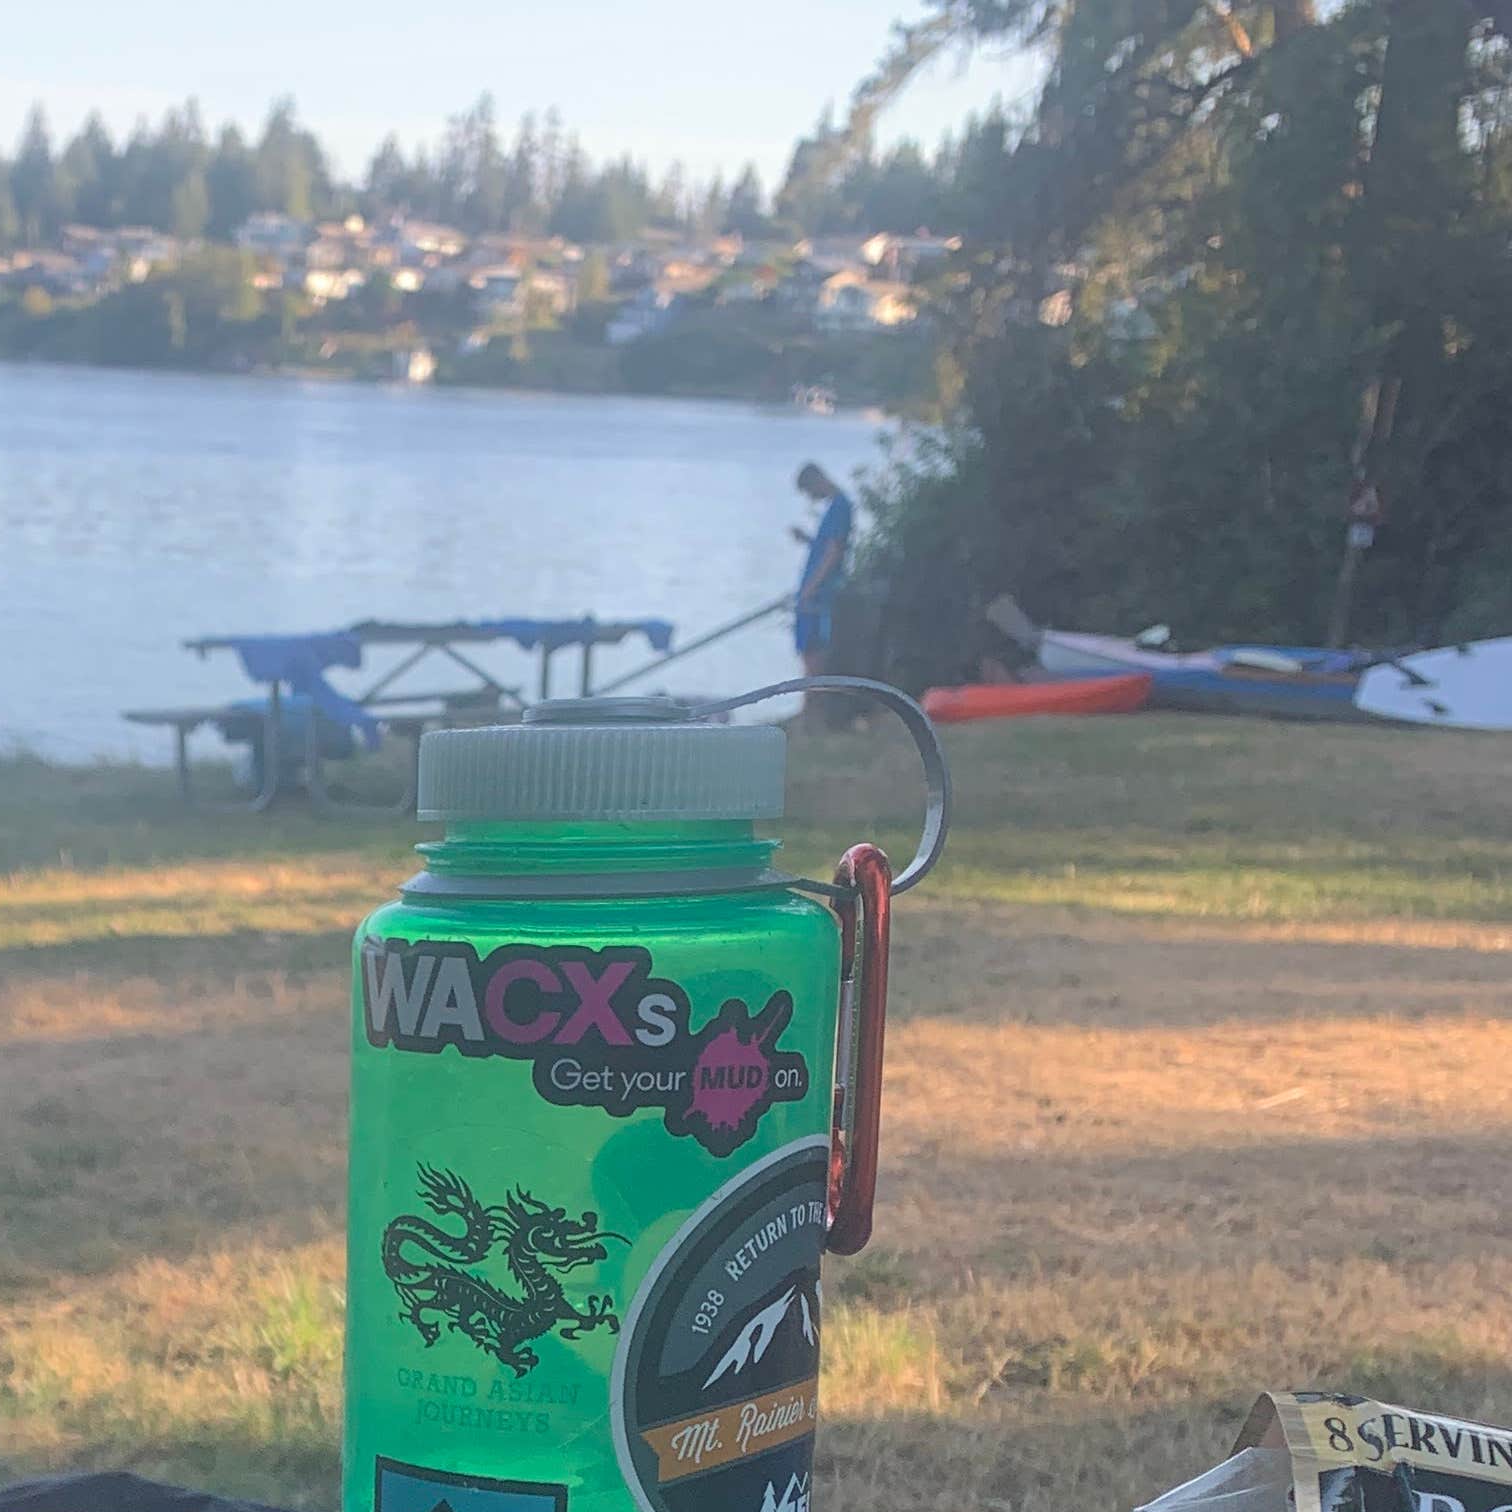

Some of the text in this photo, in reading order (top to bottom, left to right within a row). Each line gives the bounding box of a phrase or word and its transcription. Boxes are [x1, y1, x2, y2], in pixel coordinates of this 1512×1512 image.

[365, 947, 678, 1047] WACXs
[550, 1058, 803, 1101] Get your MUD on.
[691, 1289, 725, 1334] 1938
[724, 1213, 788, 1282] RETURN
[790, 1204, 806, 1229] TO
[397, 1367, 582, 1405] GRAND ASIAN
[415, 1398, 551, 1434] JOURNEYS
[670, 1417, 723, 1464] Mt.
[735, 1395, 805, 1453] Rainier
[1323, 1416, 1354, 1452] 8
